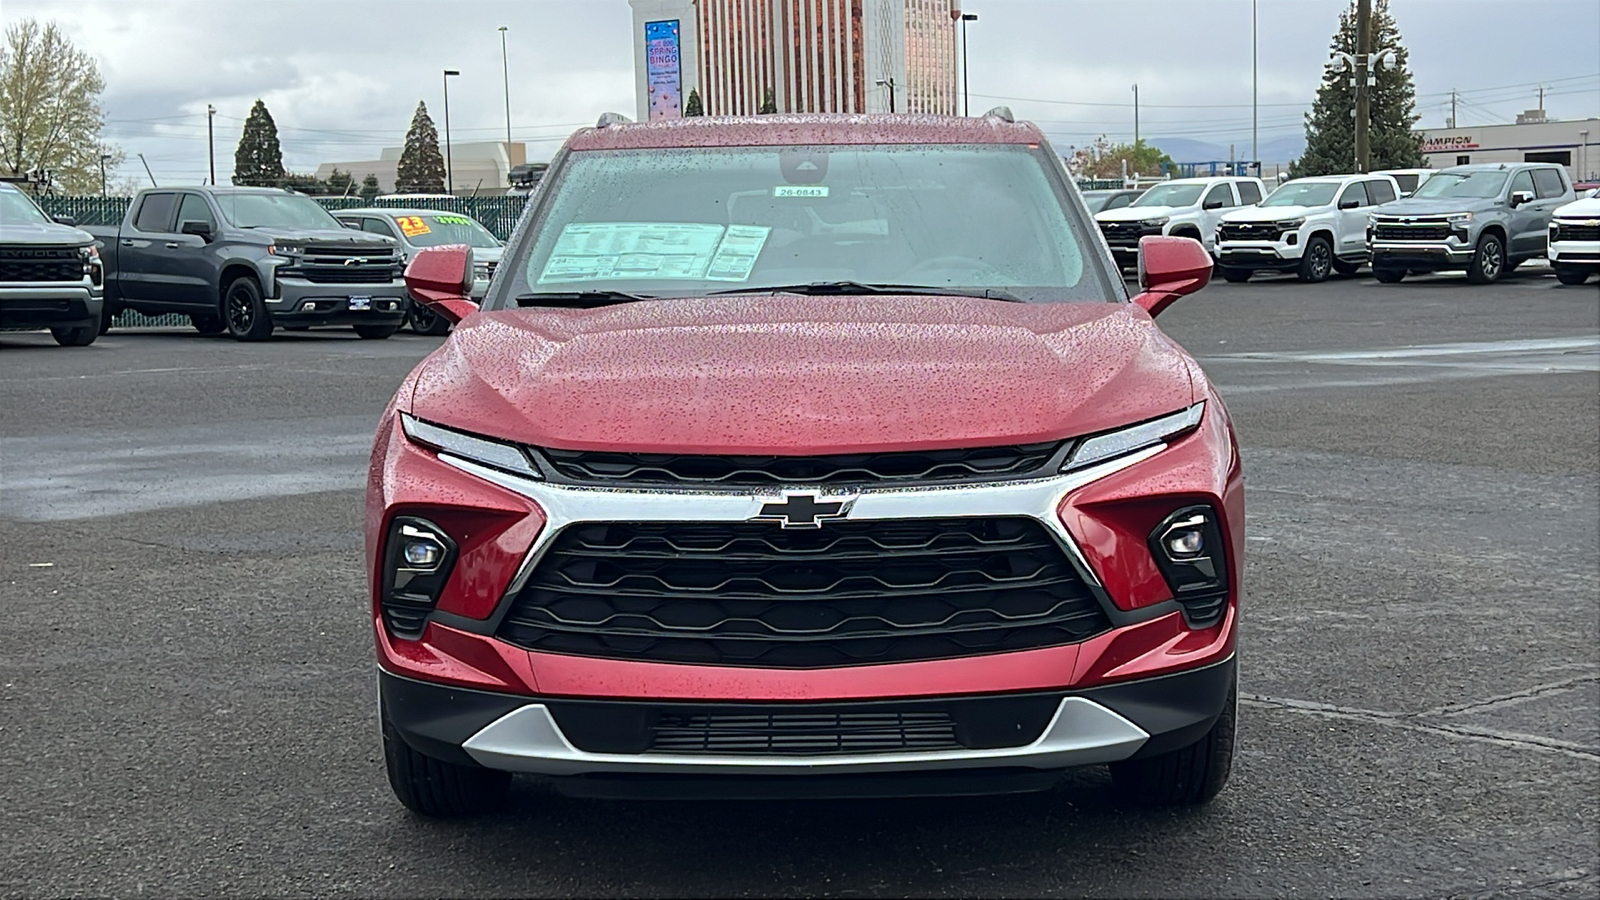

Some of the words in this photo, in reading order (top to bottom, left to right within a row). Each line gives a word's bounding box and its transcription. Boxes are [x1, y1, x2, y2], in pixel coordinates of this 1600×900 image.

[650, 46, 677, 56] SPRING
[650, 54, 677, 64] BINGO
[1426, 136, 1472, 145] AMPION
[397, 216, 424, 230] 23
[0, 248, 78, 258] EVROLET
